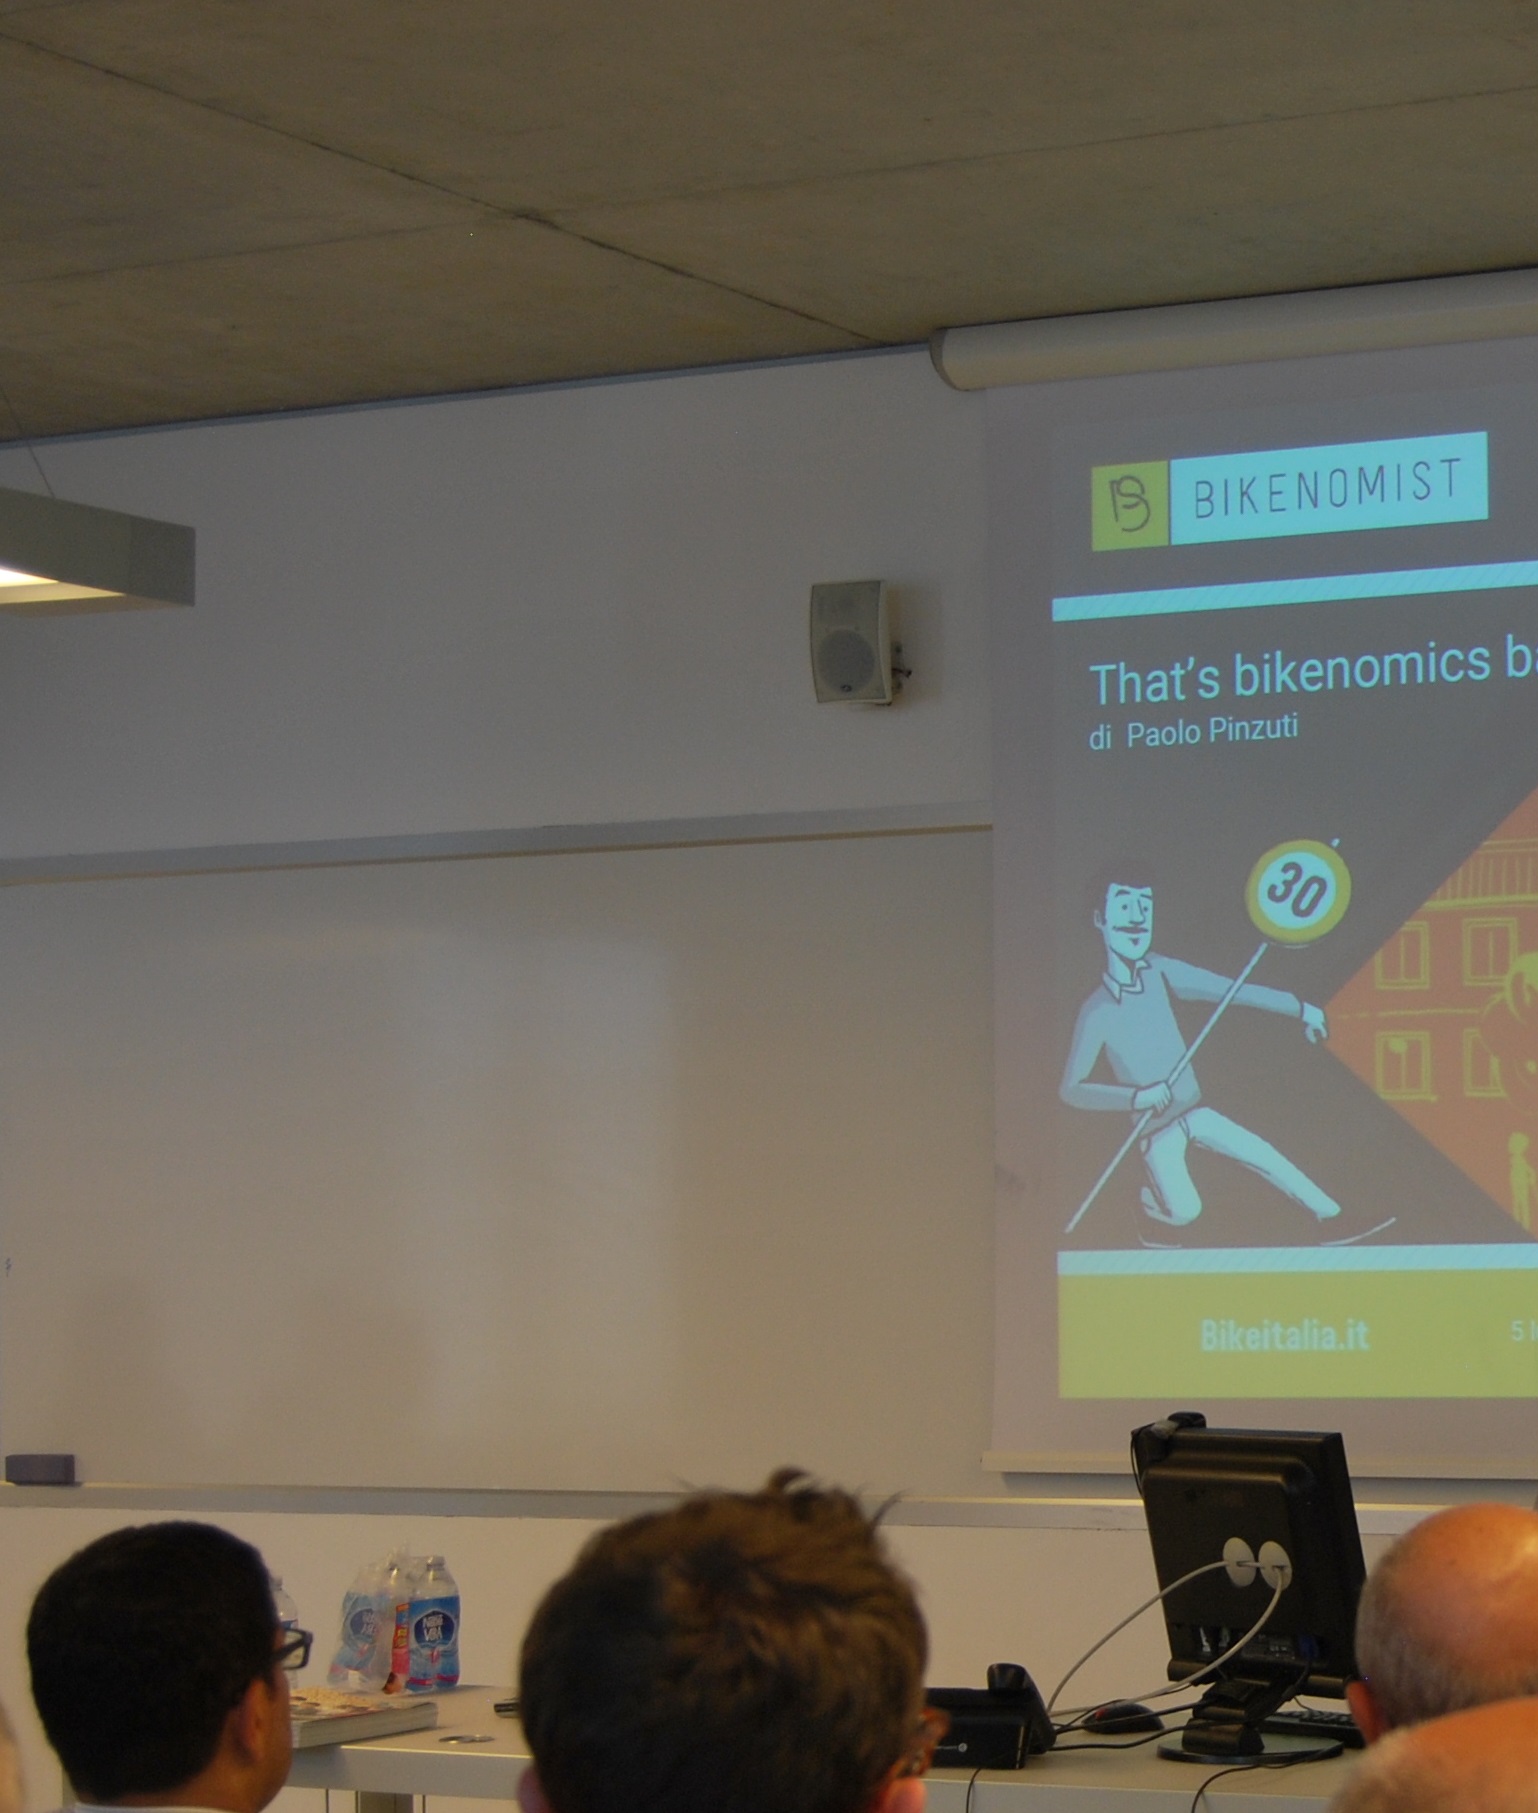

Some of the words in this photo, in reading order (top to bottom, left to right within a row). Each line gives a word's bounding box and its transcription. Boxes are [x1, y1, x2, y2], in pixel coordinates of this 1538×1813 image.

[1194, 457, 1462, 519] BIKENOMIST
[1090, 656, 1221, 706] That’s
[1235, 640, 1492, 697] bikenomics
[1089, 724, 1112, 751] di
[1127, 717, 1201, 748] Paolo
[1209, 712, 1299, 743] Pinzuti
[1267, 861, 1328, 918] 30
[1200, 1318, 1371, 1352] Bikeitalia.it
[1511, 1319, 1524, 1342] 5
